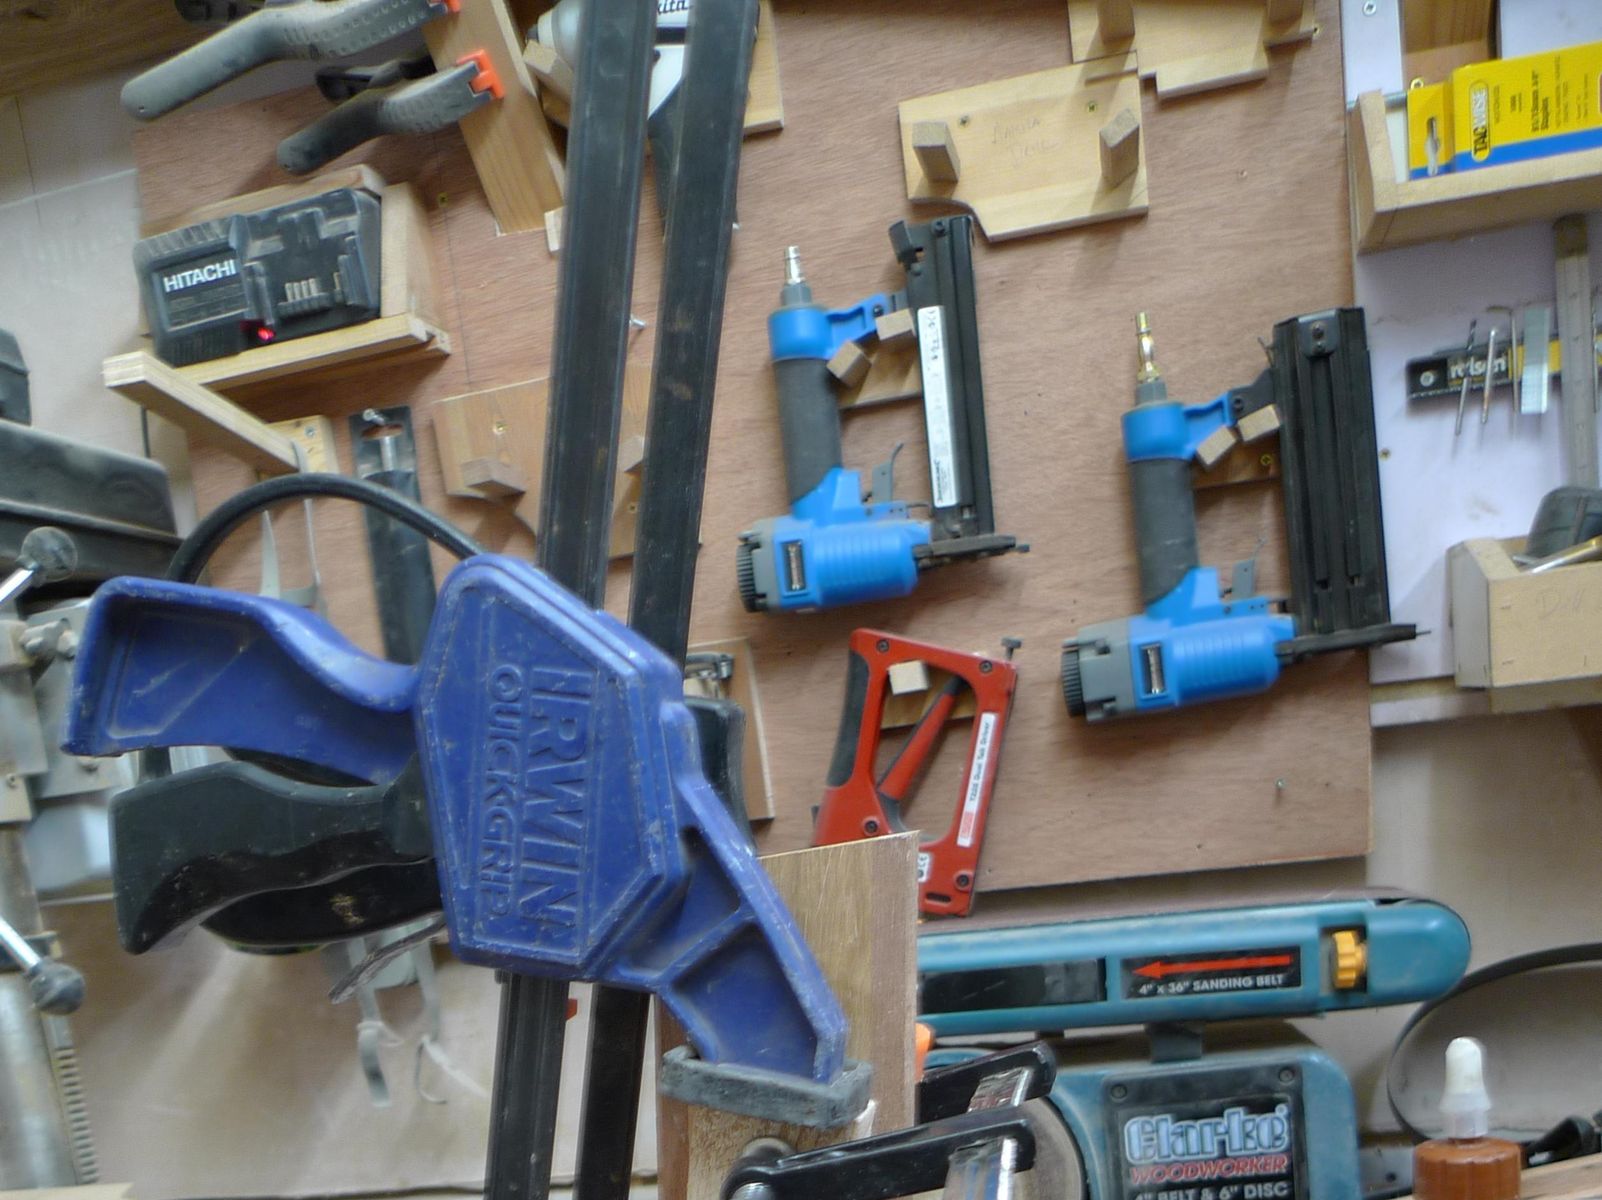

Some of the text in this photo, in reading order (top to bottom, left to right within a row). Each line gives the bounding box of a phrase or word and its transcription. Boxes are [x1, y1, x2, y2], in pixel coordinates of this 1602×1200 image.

[1471, 87, 1488, 155] TACWISE
[163, 258, 239, 293] HITACHI
[517, 666, 595, 931] IRWIN
[1168, 981, 1189, 994] 36"
[1192, 975, 1253, 992] SANDING
[1256, 973, 1285, 987] BELT
[1123, 1105, 1288, 1165] Clarke
[1129, 1153, 1289, 1185] WOODWORKER
[1243, 1180, 1289, 1200] DISC
